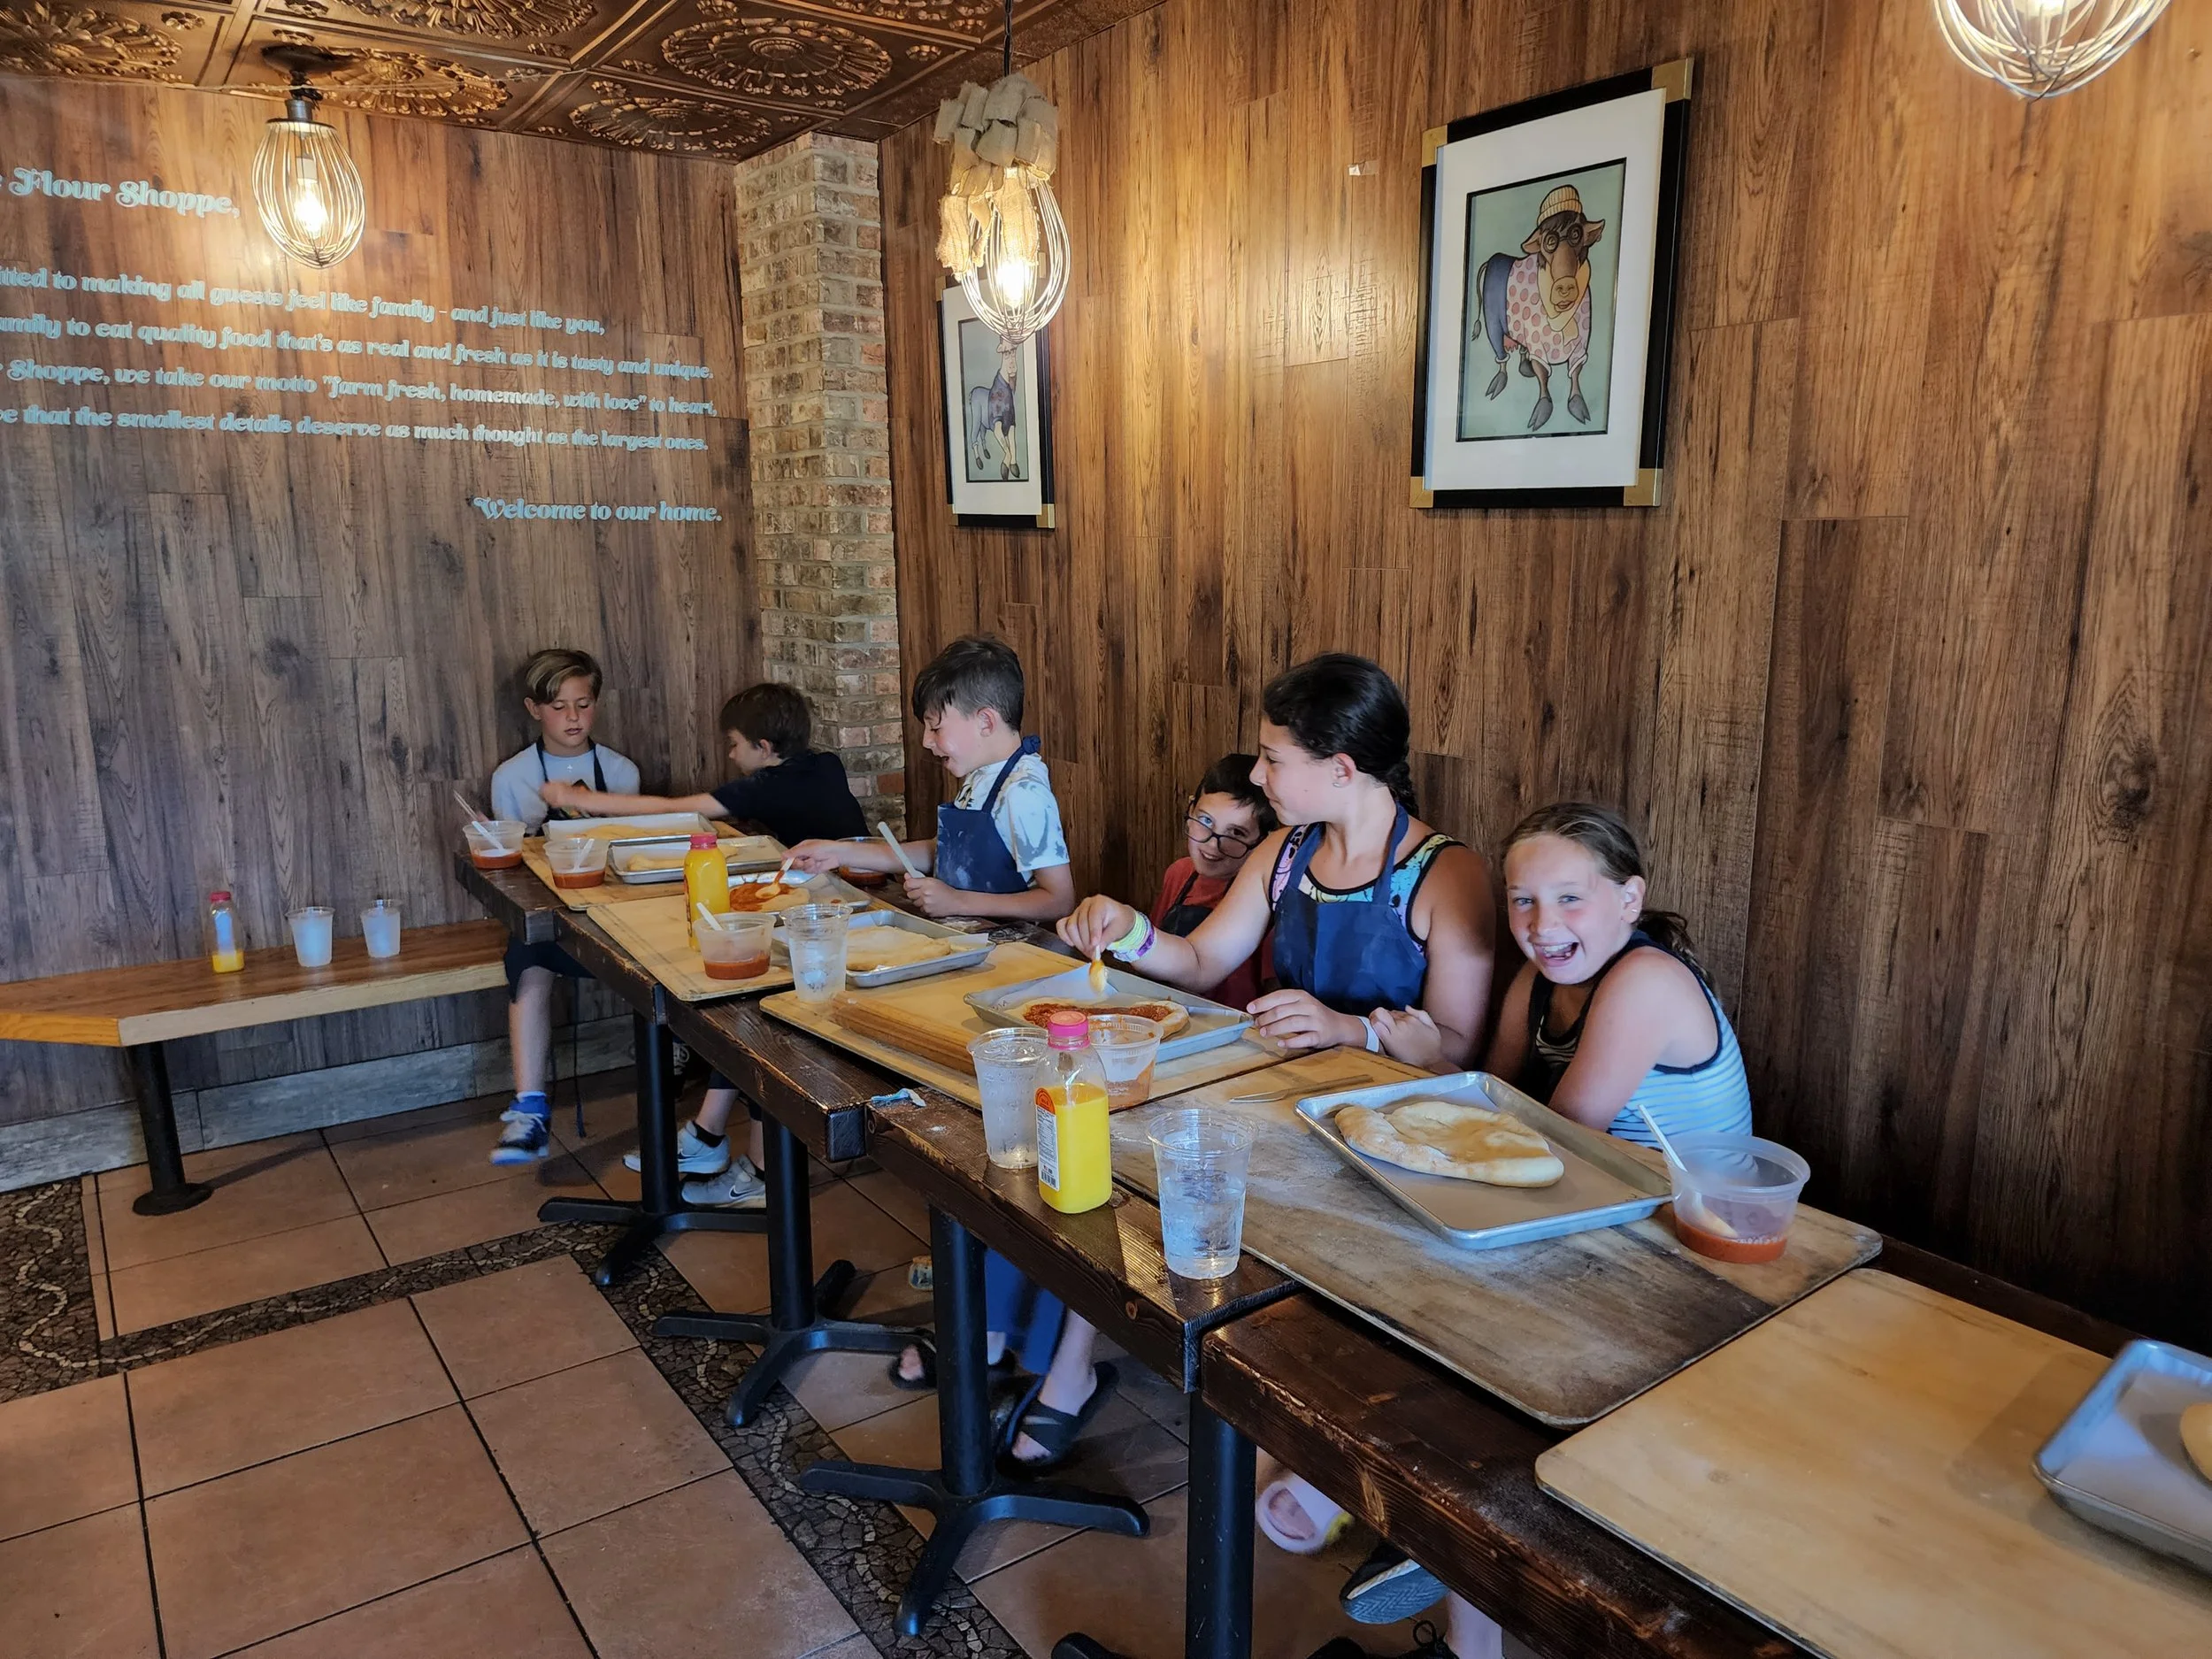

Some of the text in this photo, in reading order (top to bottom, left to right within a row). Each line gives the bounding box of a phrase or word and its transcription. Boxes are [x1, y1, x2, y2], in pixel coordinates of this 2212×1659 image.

[9, 166, 239, 218] Flour Shoppe,
[52, 271, 77, 291] to
[81, 272, 173, 303] making
[176, 280, 205, 300] all
[210, 288, 284, 305] guests
[286, 290, 326, 311] feel
[330, 292, 368, 313] like
[368, 296, 435, 323] family
[450, 305, 488, 324] and
[488, 305, 526, 329] just
[529, 310, 564, 330] like
[565, 318, 605, 335] you,
[65, 318, 91, 337] to
[94, 321, 134, 340] eat
[136, 324, 218, 349] quality
[218, 326, 273, 350] food
[275, 331, 334, 352] that's
[335, 340, 363, 354] as
[366, 340, 411, 358] real
[412, 342, 452, 361] and
[453, 343, 507, 365] fresh
[510, 353, 534, 366] as
[536, 349, 549, 367] it
[551, 351, 569, 368] is
[570, 355, 615, 375] tasty
[617, 357, 651, 375] and
[652, 360, 713, 381] unique.
[6, 359, 111, 386] Shoppe,
[113, 369, 151, 385] we
[154, 367, 204, 387] take
[208, 374, 252, 389] our
[254, 375, 319, 393] motto
[384, 380, 447, 403] fresh,
[449, 383, 560, 408] homemade,
[563, 392, 601, 410] with
[648, 399, 666, 414] to
[667, 396, 718, 417] heart,
[22, 404, 72, 425] that
[74, 406, 113, 427] the
[116, 411, 215, 431] smallest
[219, 412, 293, 434] details
[296, 416, 382, 438] deserve
[385, 425, 411, 438] as
[413, 424, 470, 442] much
[472, 425, 544, 447] thought
[545, 433, 569, 445] as
[570, 429, 599, 446] the
[601, 430, 662, 451] largest
[664, 437, 708, 451] ones.
[472, 495, 722, 523] Welcome to our home.
